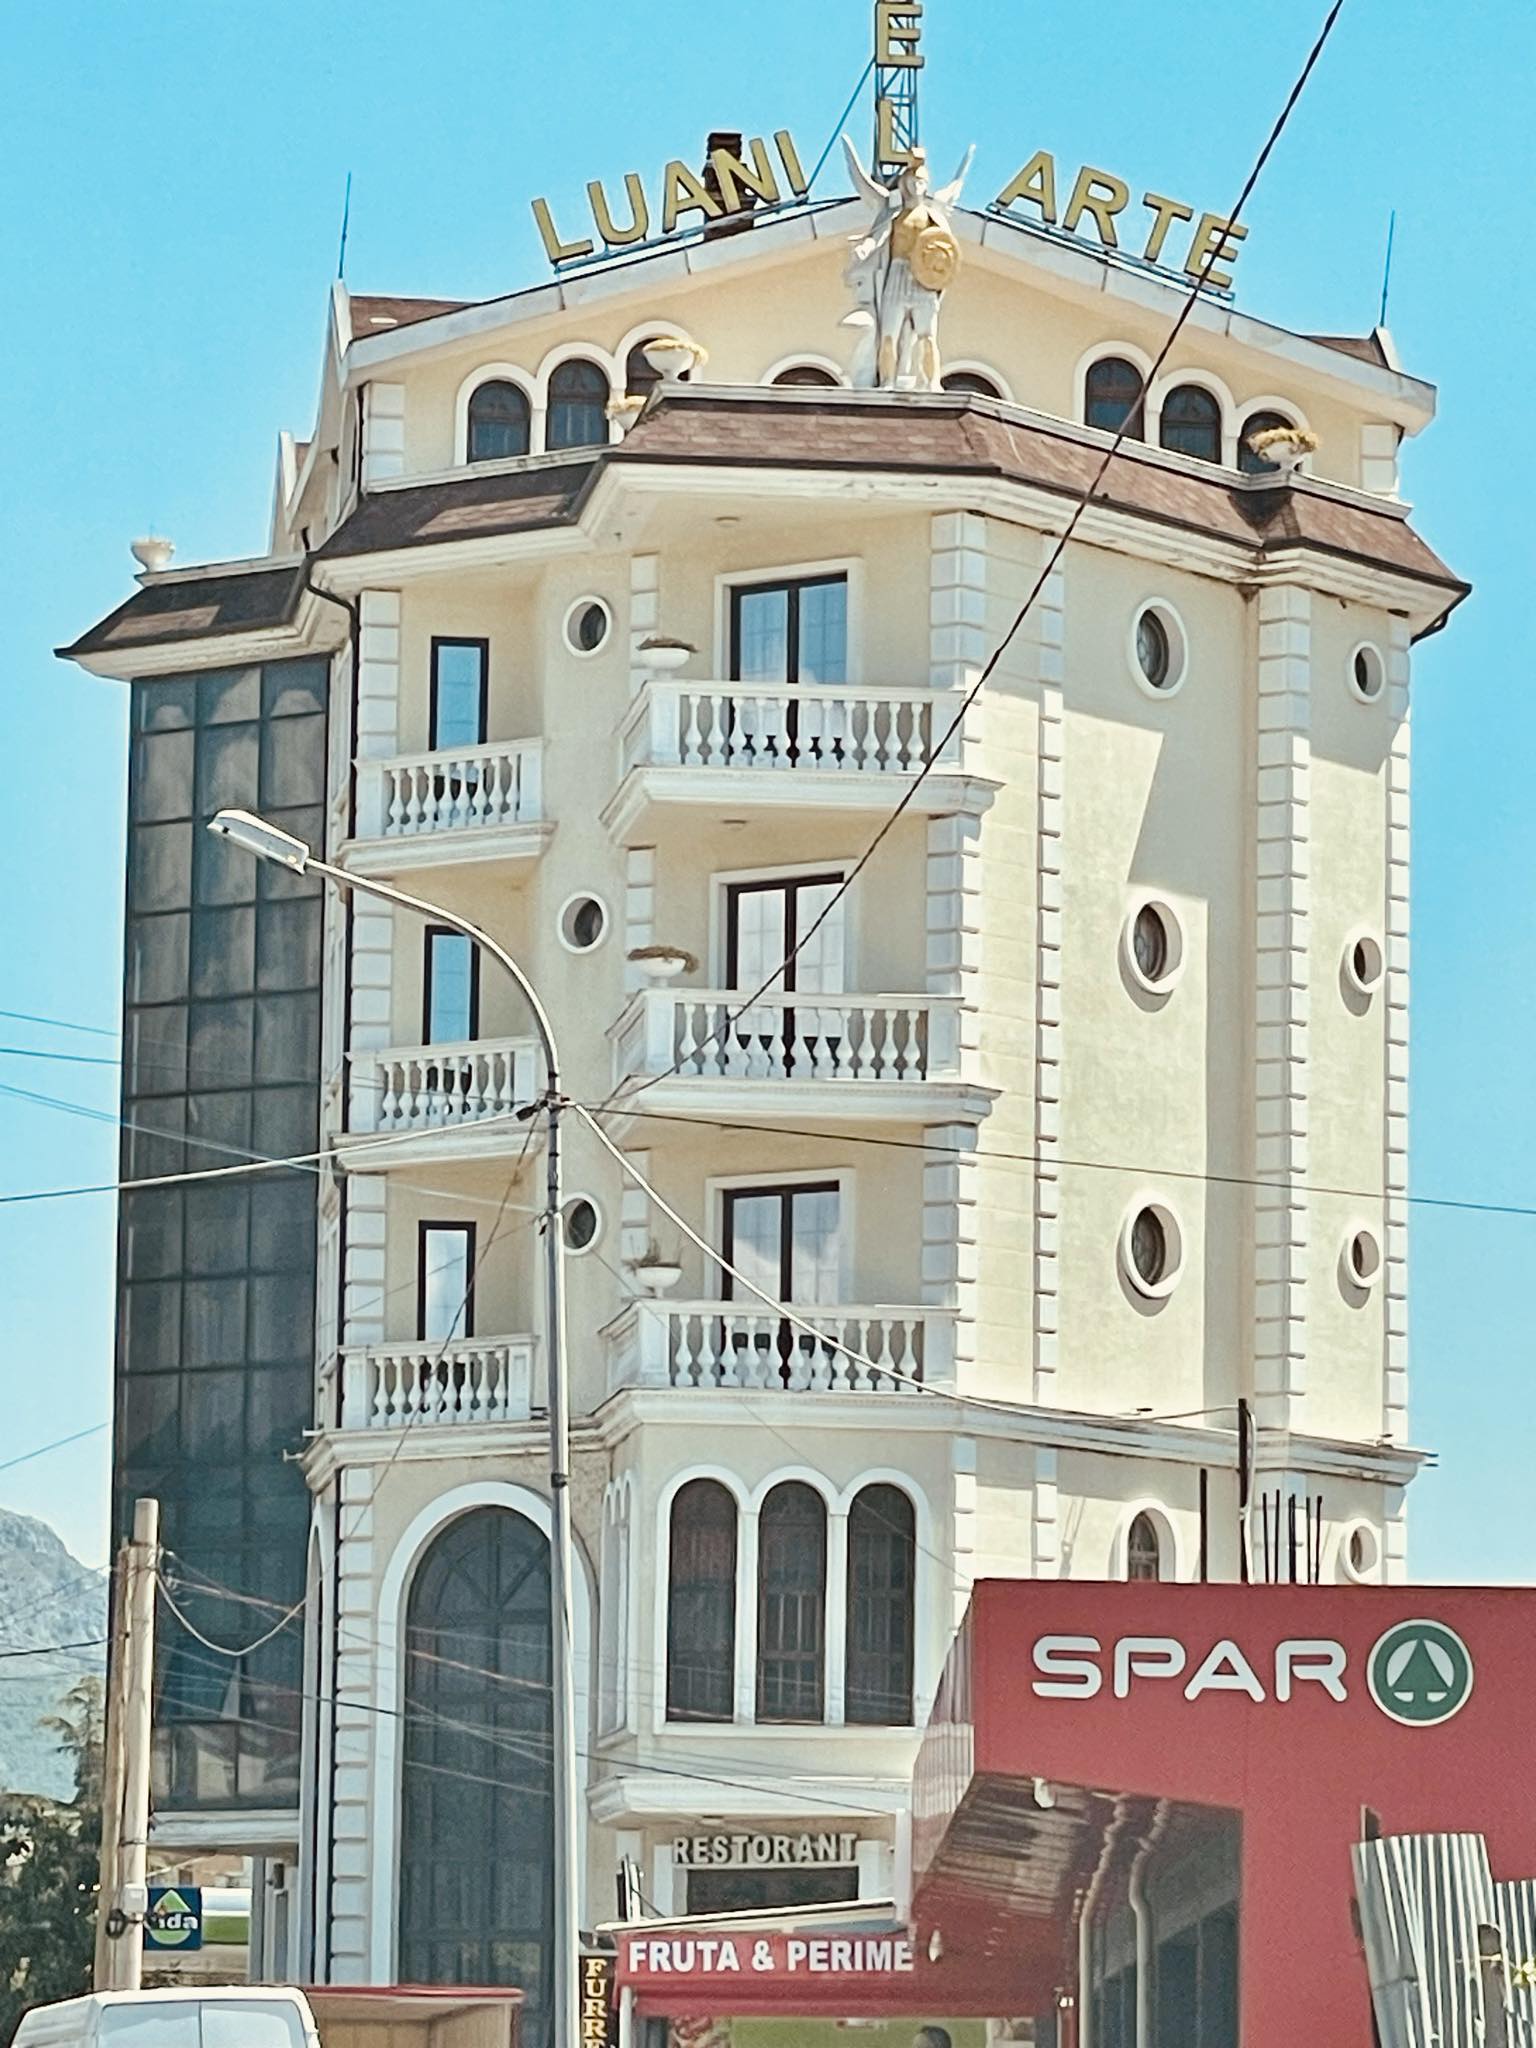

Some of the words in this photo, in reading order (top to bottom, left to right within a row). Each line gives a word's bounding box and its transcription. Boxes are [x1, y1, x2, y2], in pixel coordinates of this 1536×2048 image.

[876, 0, 925, 166] EL
[531, 131, 809, 264] LUANI
[996, 151, 1248, 289] ARTE
[1031, 1635, 1348, 1702] SPAR
[672, 1832, 858, 1865] RESTORANT
[150, 1911, 199, 1930] ida
[629, 1940, 740, 1973] FRUTA
[751, 1940, 775, 1972] &
[787, 1940, 914, 1972] PERIME
